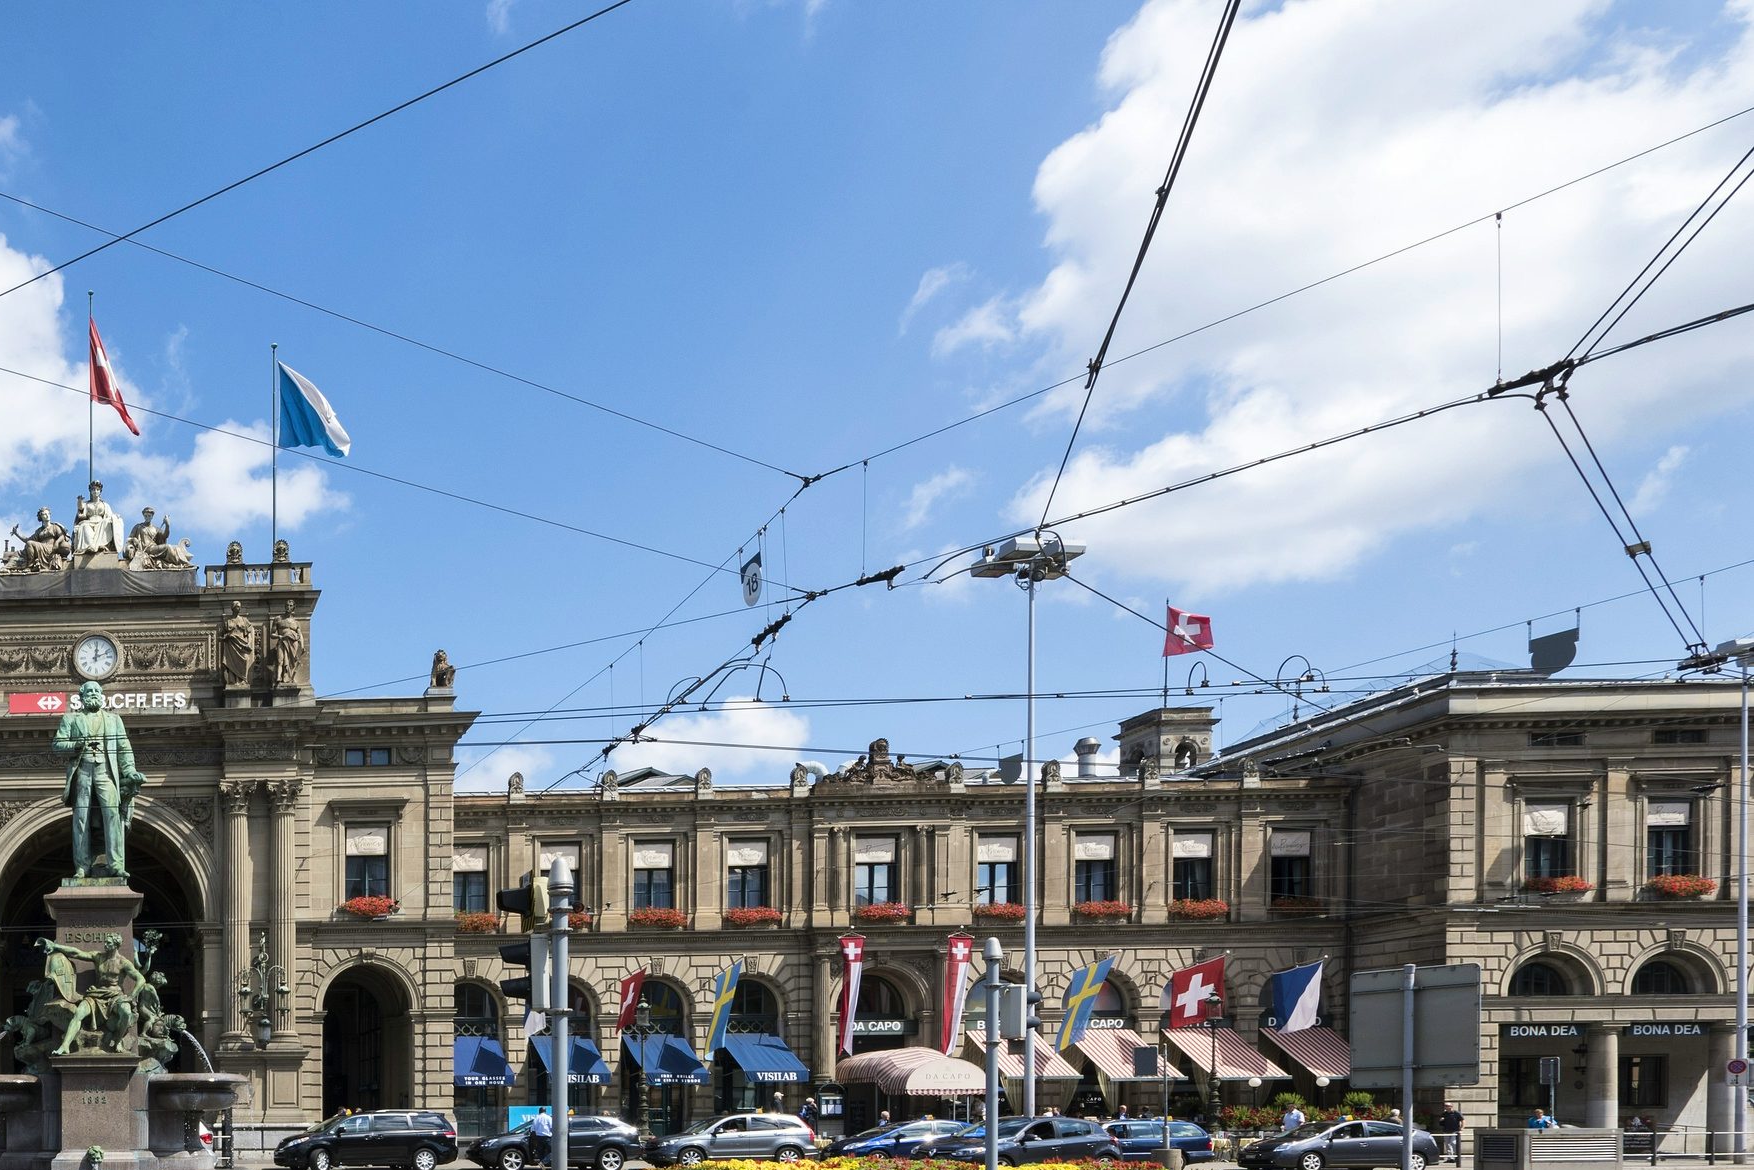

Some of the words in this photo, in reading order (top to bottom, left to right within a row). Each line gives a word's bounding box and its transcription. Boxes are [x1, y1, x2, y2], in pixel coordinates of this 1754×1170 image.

[152, 692, 186, 708] FFS
[868, 1021, 902, 1031] CAPO
[1090, 1018, 1124, 1028] CAPO
[1510, 1026, 1547, 1036] BONA
[1551, 1026, 1578, 1036] DEA
[1633, 1025, 1671, 1035] BONA
[1674, 1024, 1701, 1035] DEA
[567, 1074, 600, 1083] ISILAB
[757, 1072, 797, 1081] VISILAB
